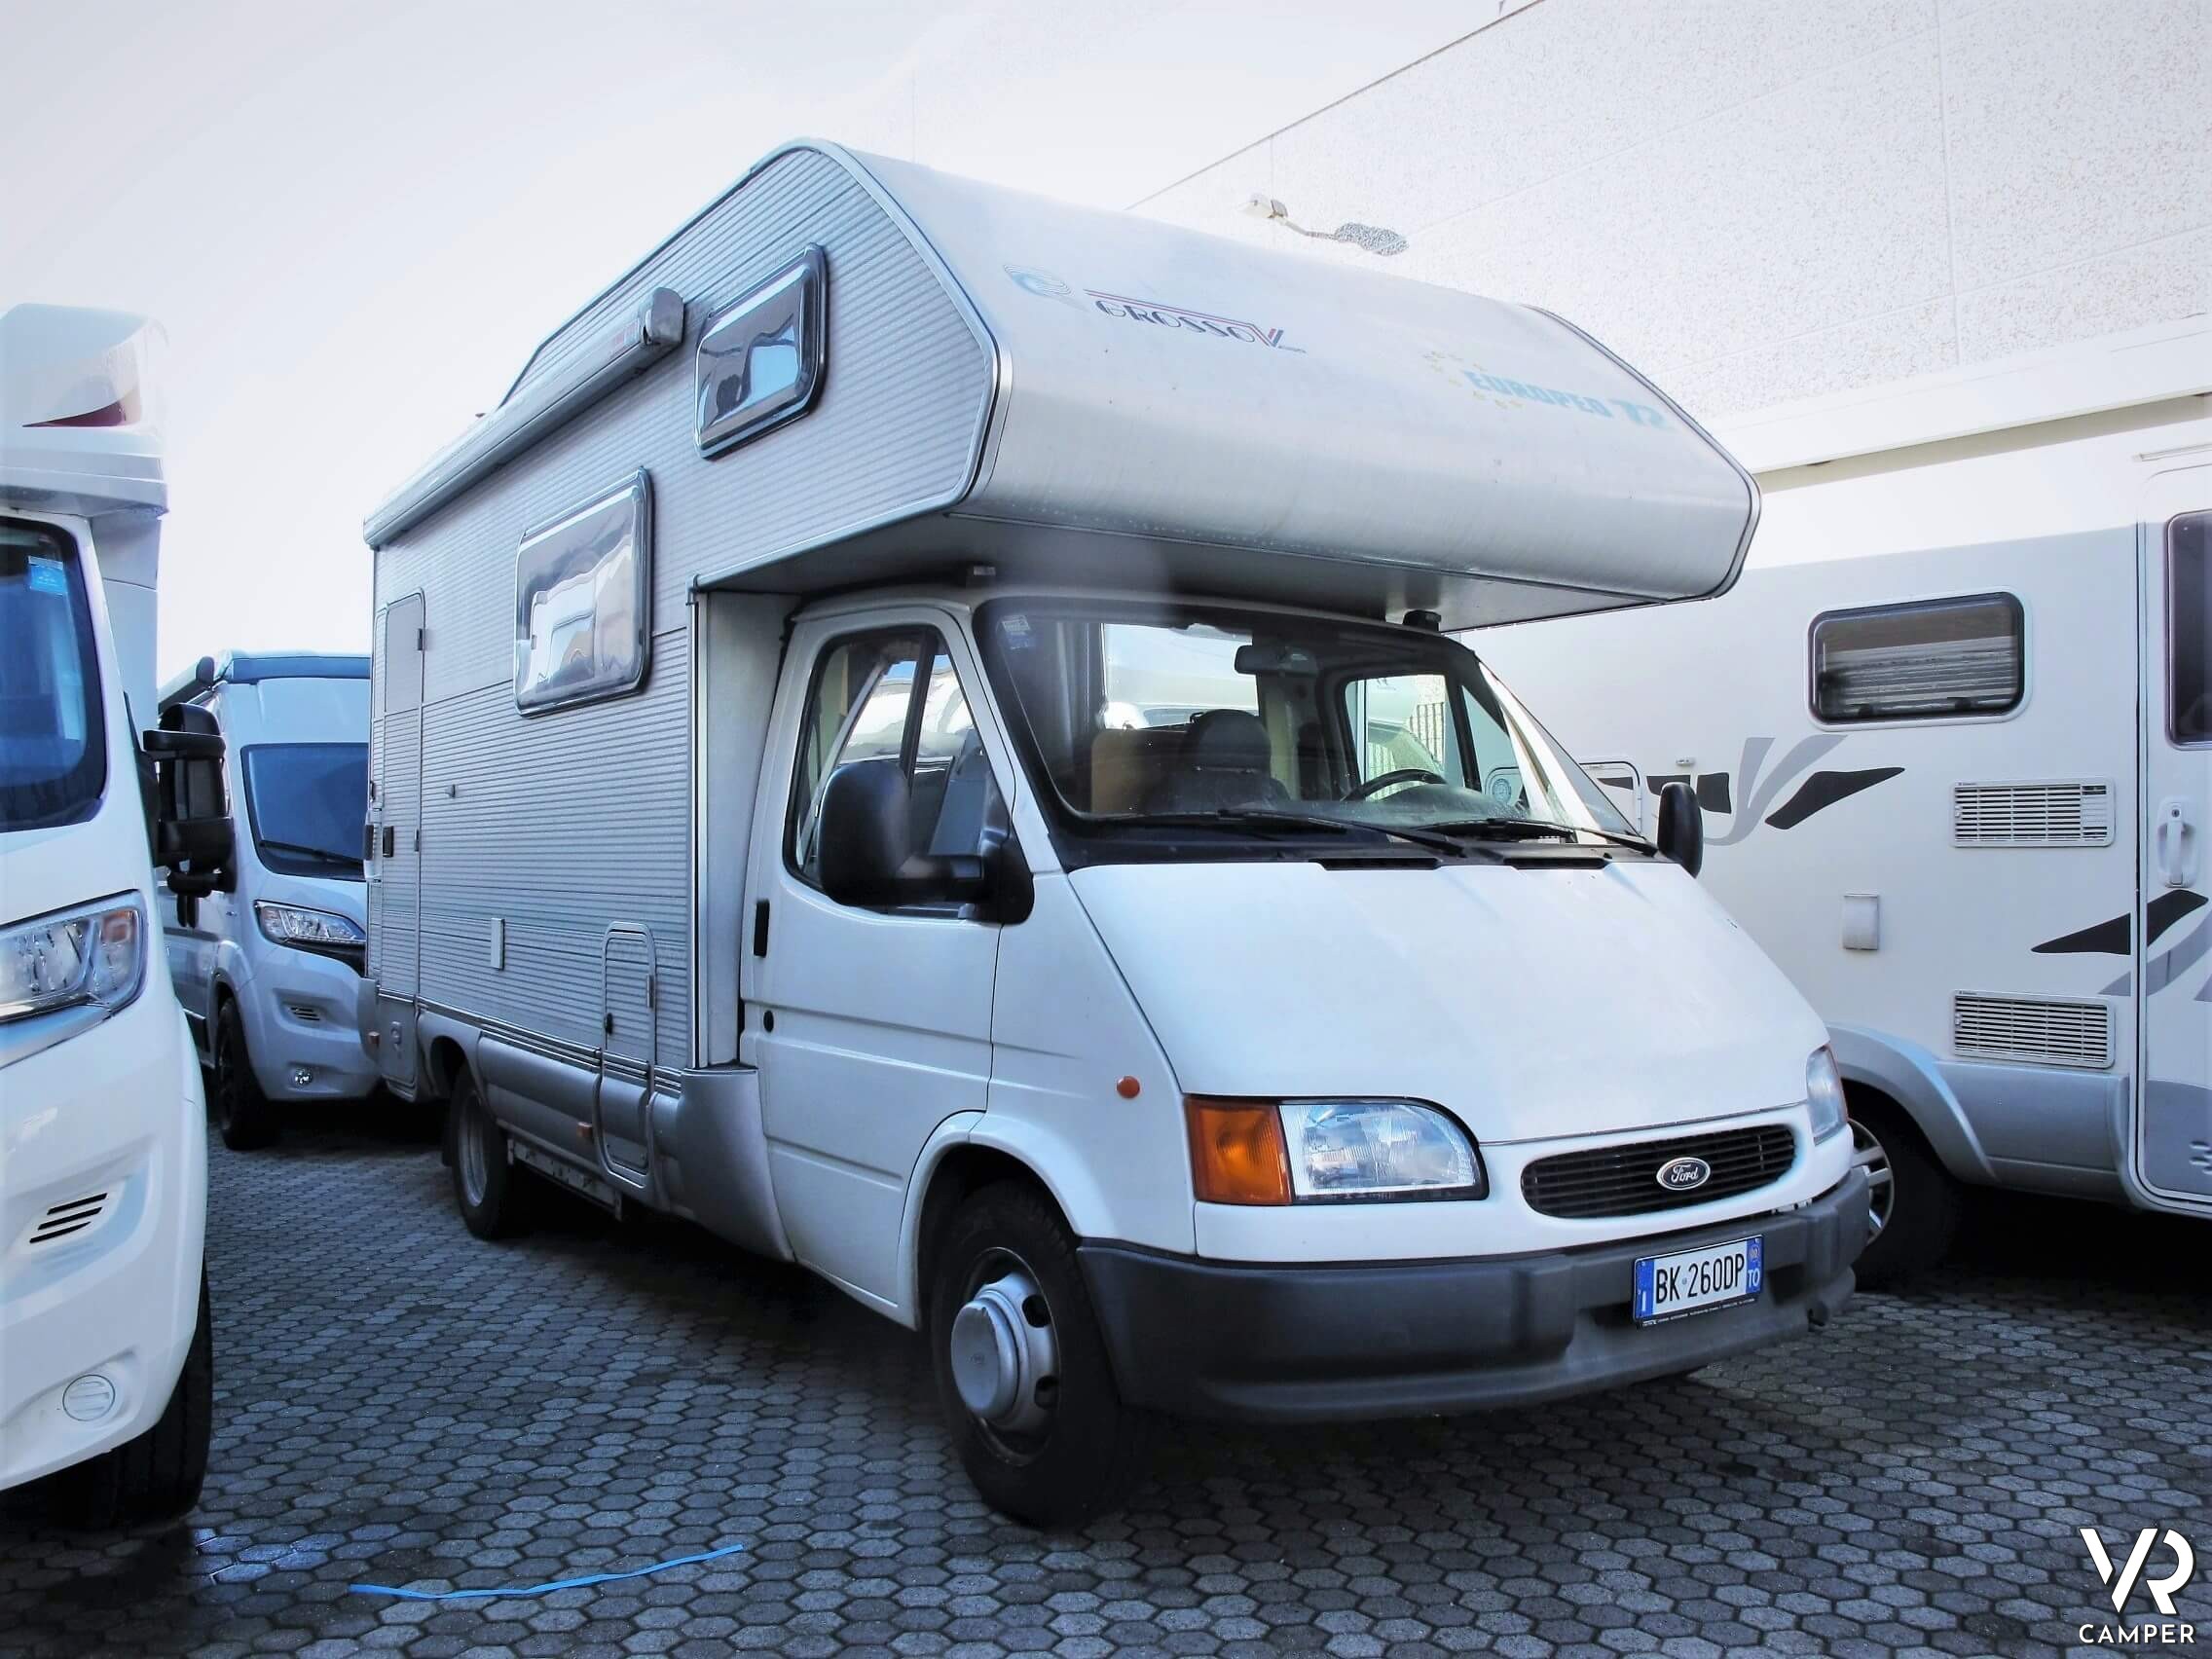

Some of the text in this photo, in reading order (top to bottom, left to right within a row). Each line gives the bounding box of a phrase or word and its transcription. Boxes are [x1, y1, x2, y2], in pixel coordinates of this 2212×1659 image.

[1671, 1163, 1699, 1184] Ford
[1655, 1265, 1681, 1305] BK
[1687, 1253, 1746, 1299] 260DP
[1748, 1268, 1760, 1288] TO
